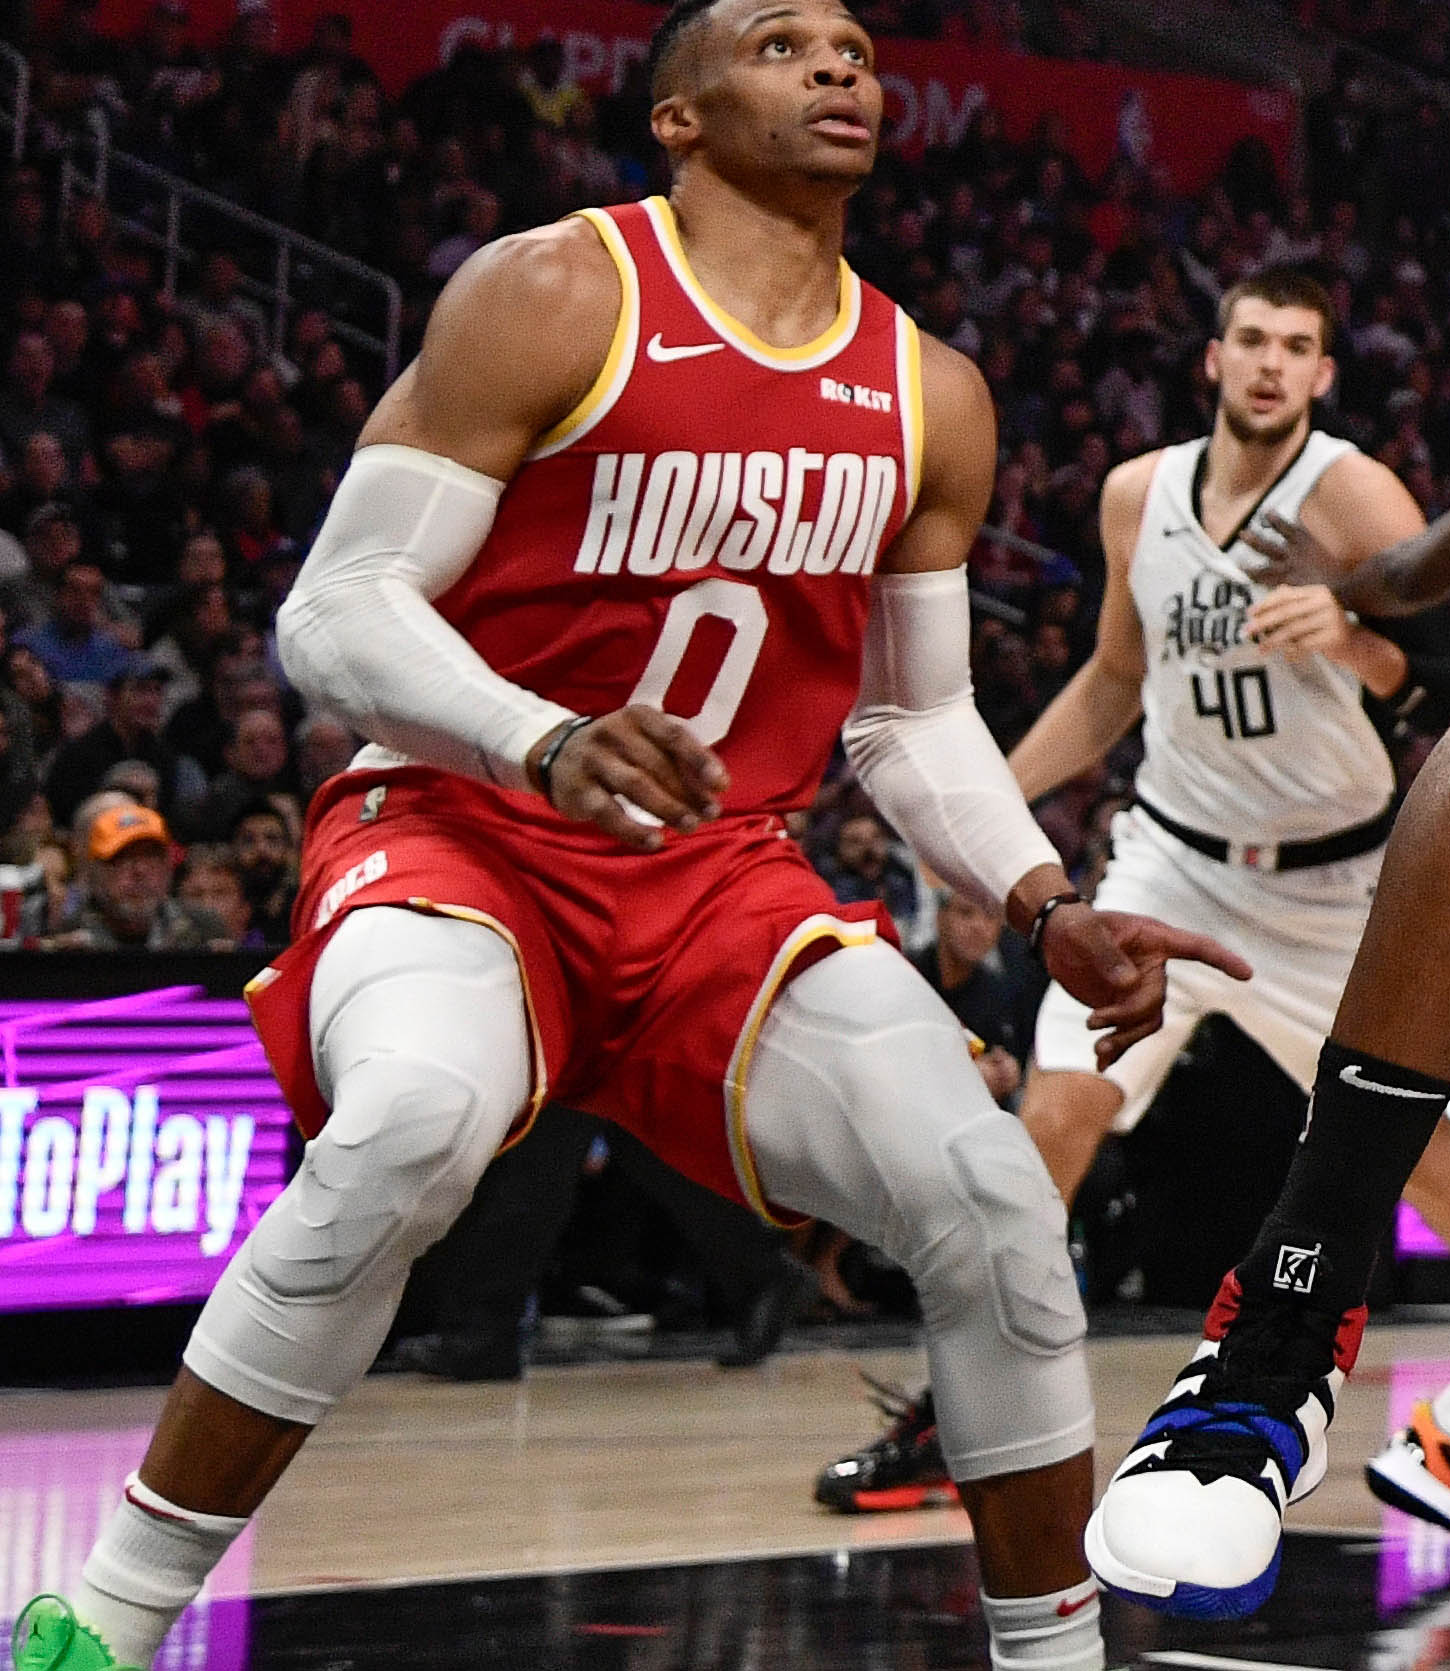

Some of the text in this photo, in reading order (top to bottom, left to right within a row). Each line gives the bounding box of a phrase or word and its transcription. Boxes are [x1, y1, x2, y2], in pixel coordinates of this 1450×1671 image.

[573, 447, 898, 577] HOUSTON
[626, 577, 769, 747] 0
[1191, 665, 1275, 740] 40
